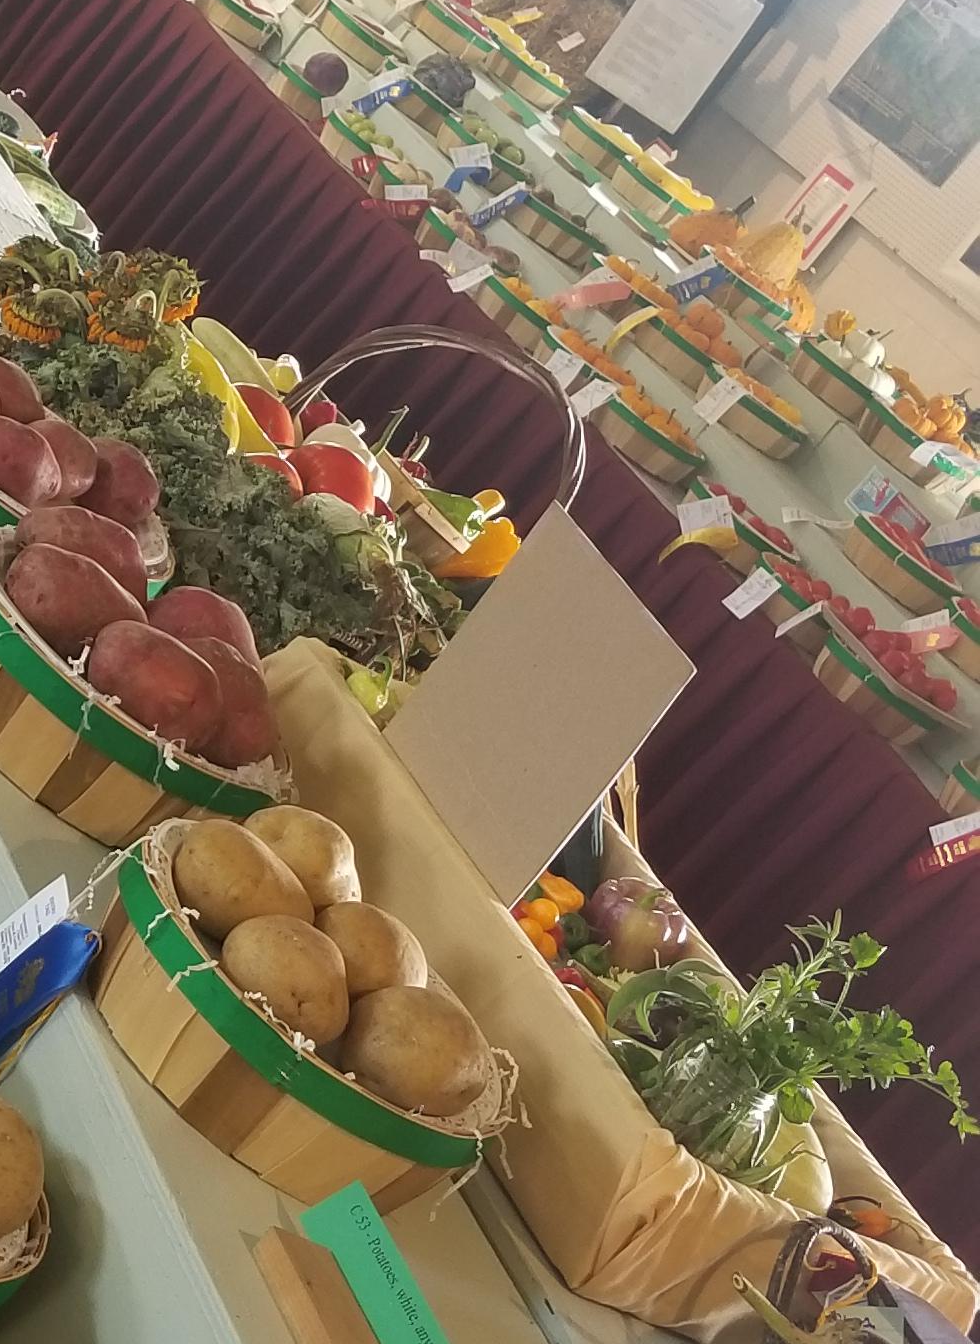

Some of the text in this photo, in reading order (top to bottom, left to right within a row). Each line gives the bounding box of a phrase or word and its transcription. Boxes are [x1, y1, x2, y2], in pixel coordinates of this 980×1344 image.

[350, 1204, 362, 1216] C
[355, 1216, 372, 1231] 53
[368, 1237, 398, 1289] Potatoes,
[396, 1288, 419, 1326] white,
